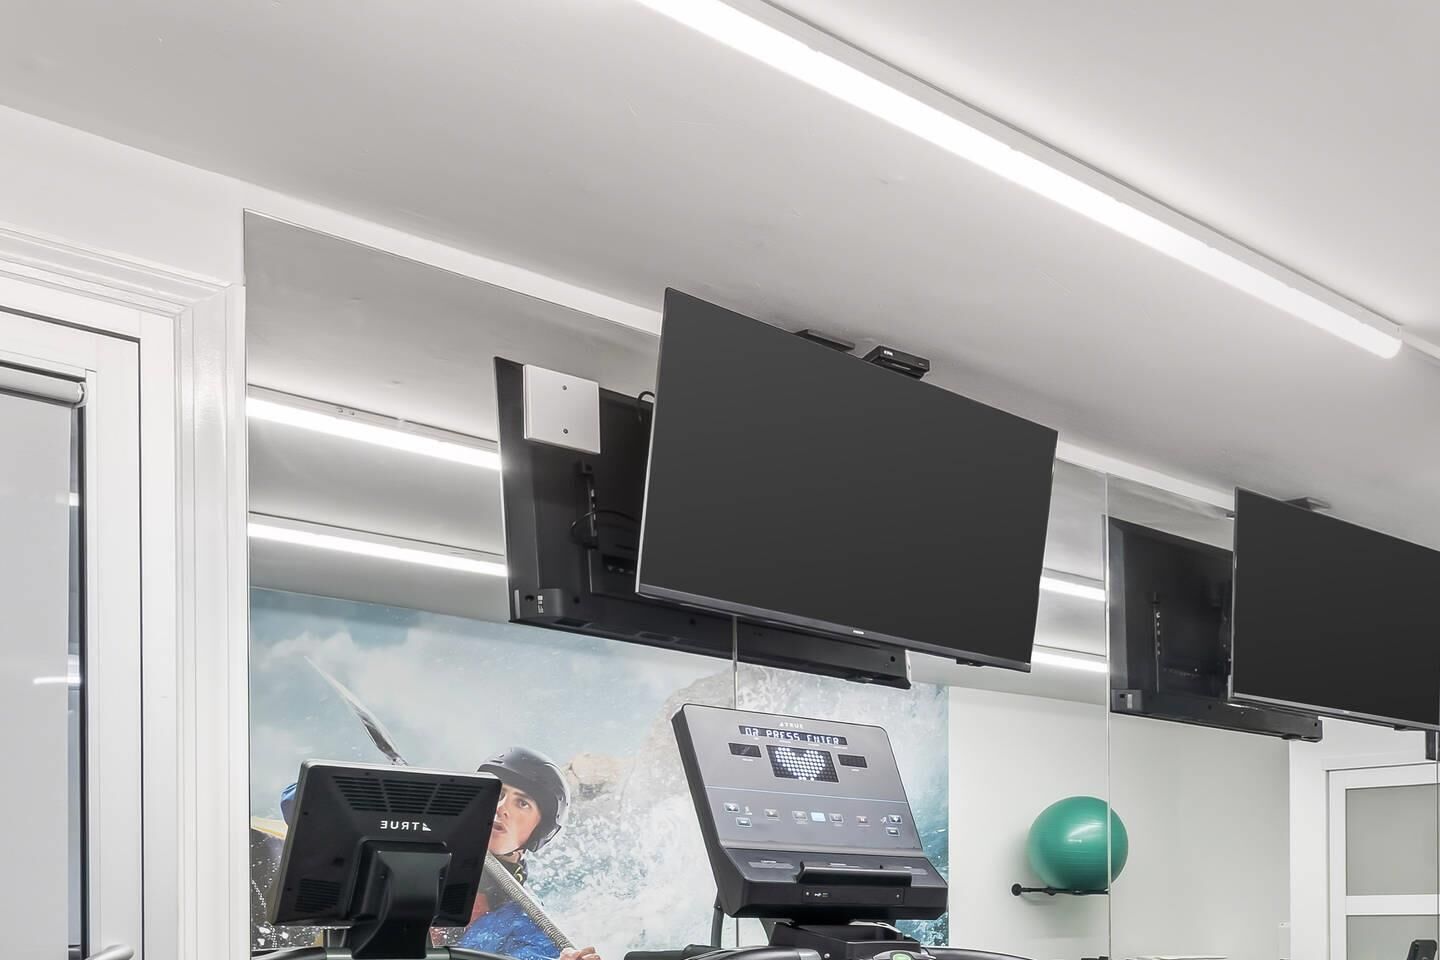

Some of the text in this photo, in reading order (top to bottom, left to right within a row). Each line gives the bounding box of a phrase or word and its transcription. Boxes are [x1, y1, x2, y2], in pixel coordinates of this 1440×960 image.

[745, 727, 759, 737] OR
[766, 729, 801, 741] PRESS
[807, 735, 840, 745] ENTER
